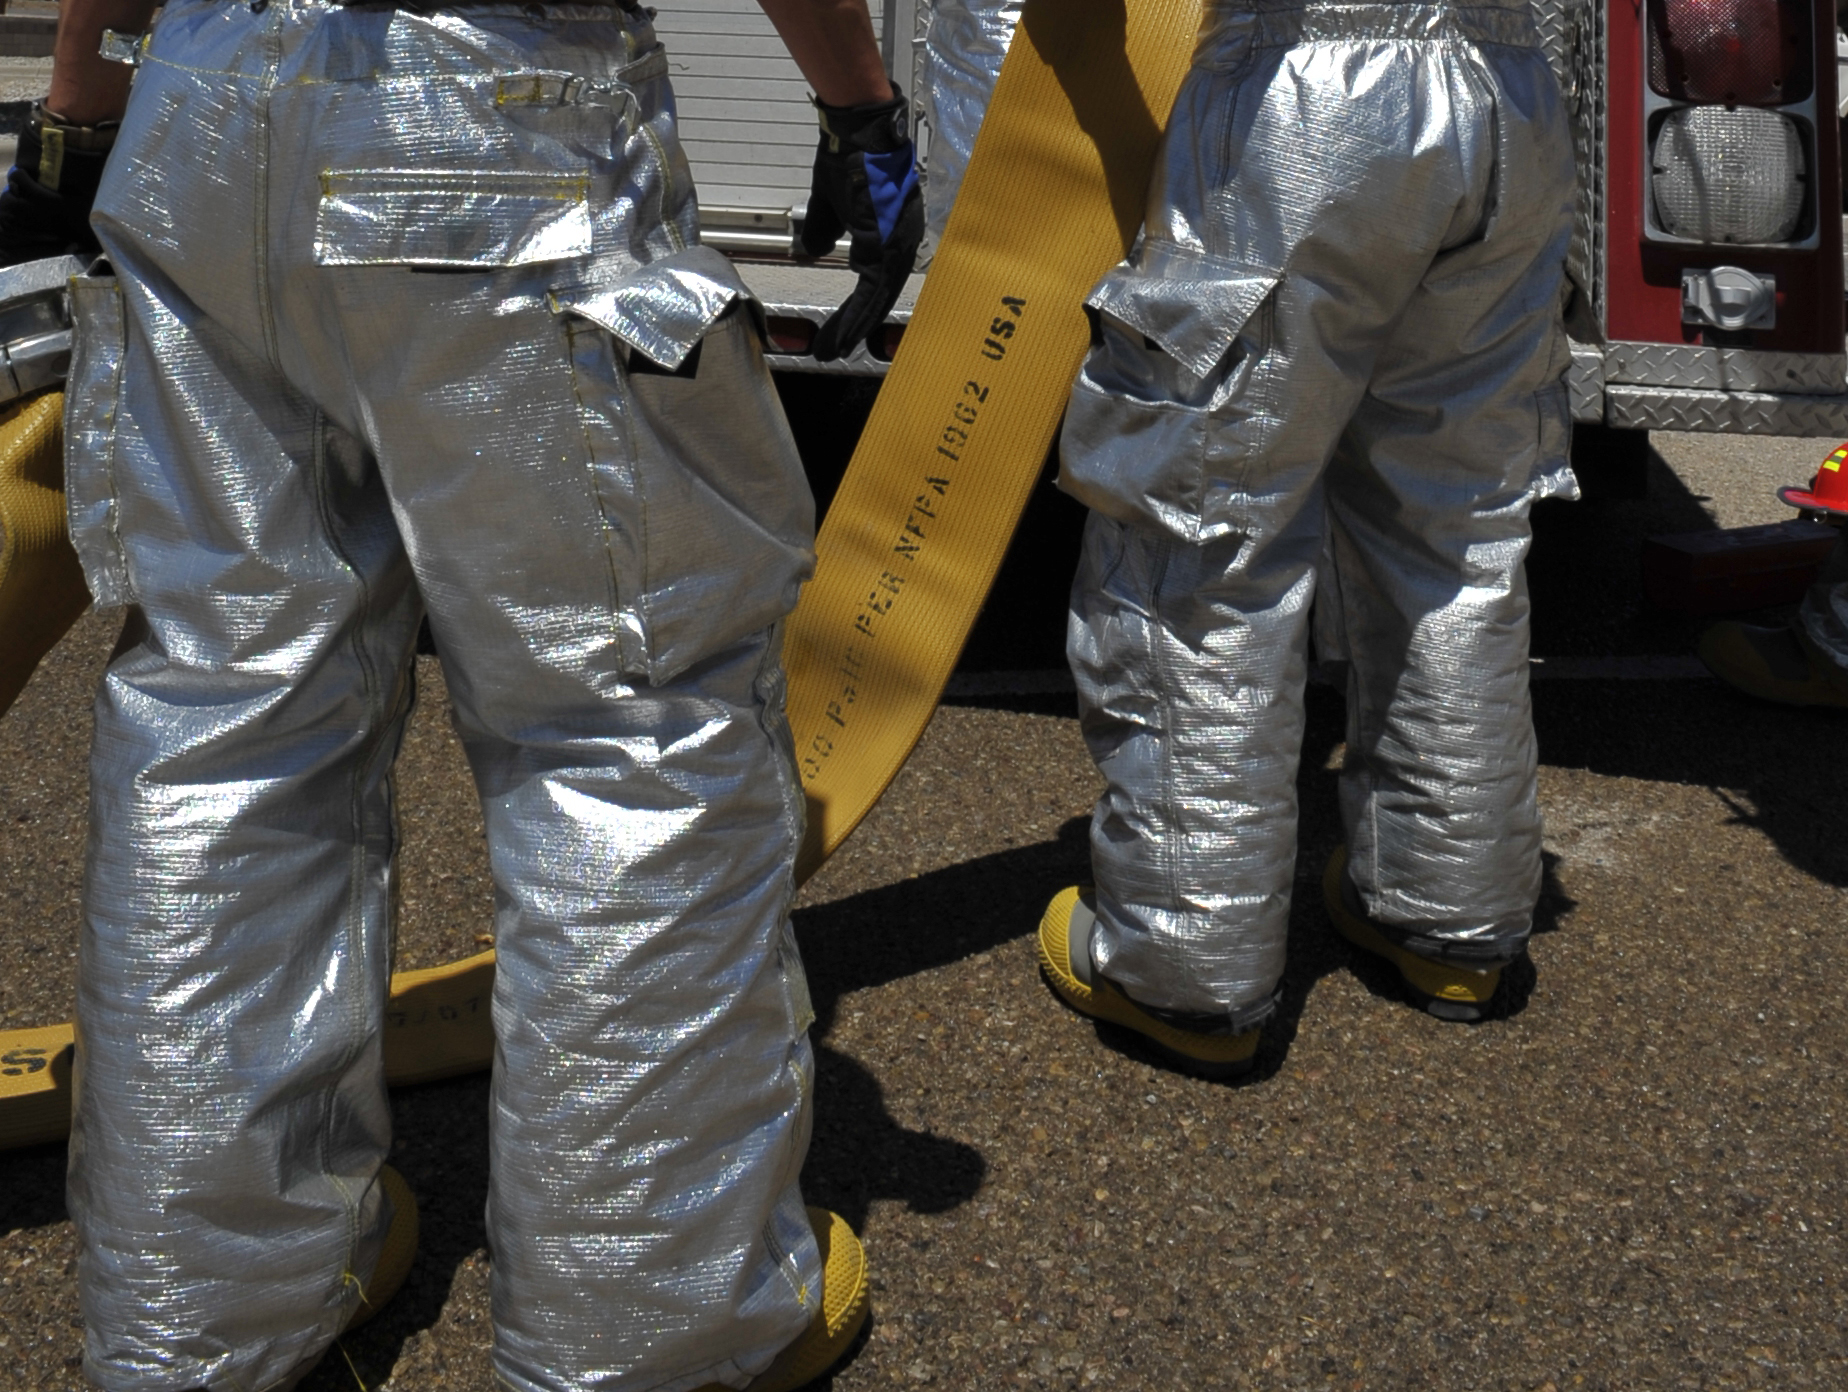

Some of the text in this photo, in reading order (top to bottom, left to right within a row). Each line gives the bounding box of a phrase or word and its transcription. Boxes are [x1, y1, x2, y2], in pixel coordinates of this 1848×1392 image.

[855, 570, 906, 638] PER
[893, 476, 950, 562] NFPA
[936, 380, 990, 462] 1962
[981, 295, 1027, 361] USA
